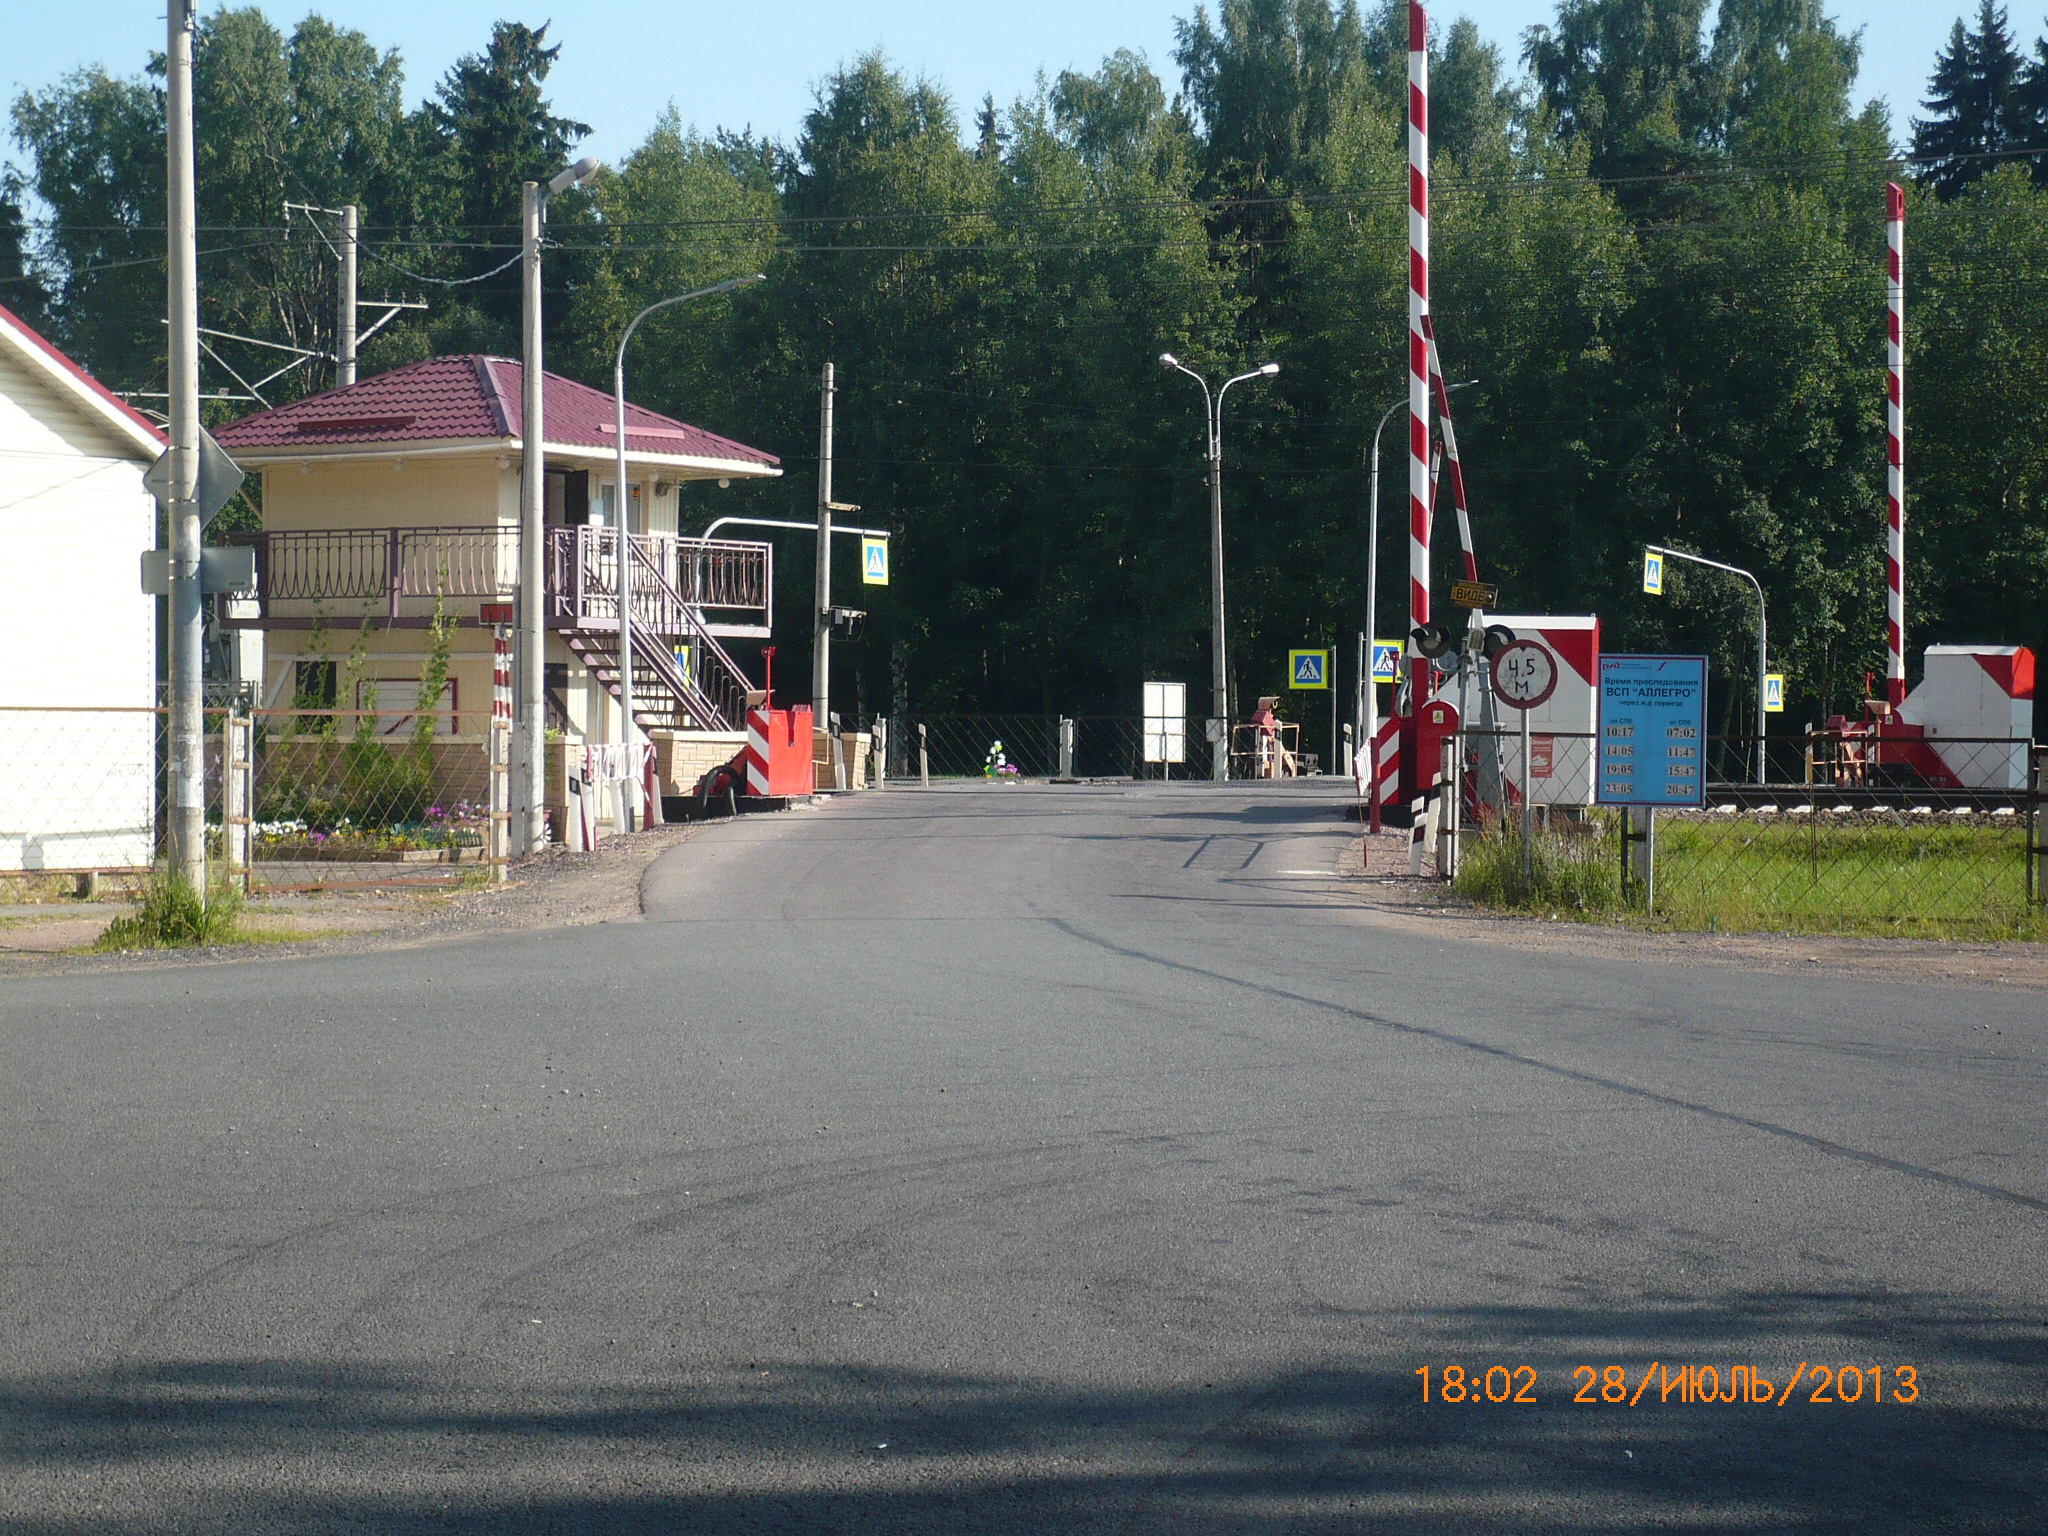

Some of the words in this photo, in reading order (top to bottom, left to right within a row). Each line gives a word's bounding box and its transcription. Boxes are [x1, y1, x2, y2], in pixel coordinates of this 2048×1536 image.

[1604, 677, 1631, 686] Время
[1633, 678, 1699, 687] проследования
[1606, 687, 1630, 697] ВСП
[1654, 700, 1684, 708] переезд
[1606, 727, 1634, 737] 10:17
[1666, 728, 1696, 738] 07:02
[1607, 745, 1633, 756] 14:05
[1668, 747, 1695, 757] 11:47
[1606, 765, 1633, 775] 19:05
[1669, 766, 1696, 776] 15:47
[1605, 783, 1633, 794] 23:05
[1666, 784, 1695, 795] 20:47
